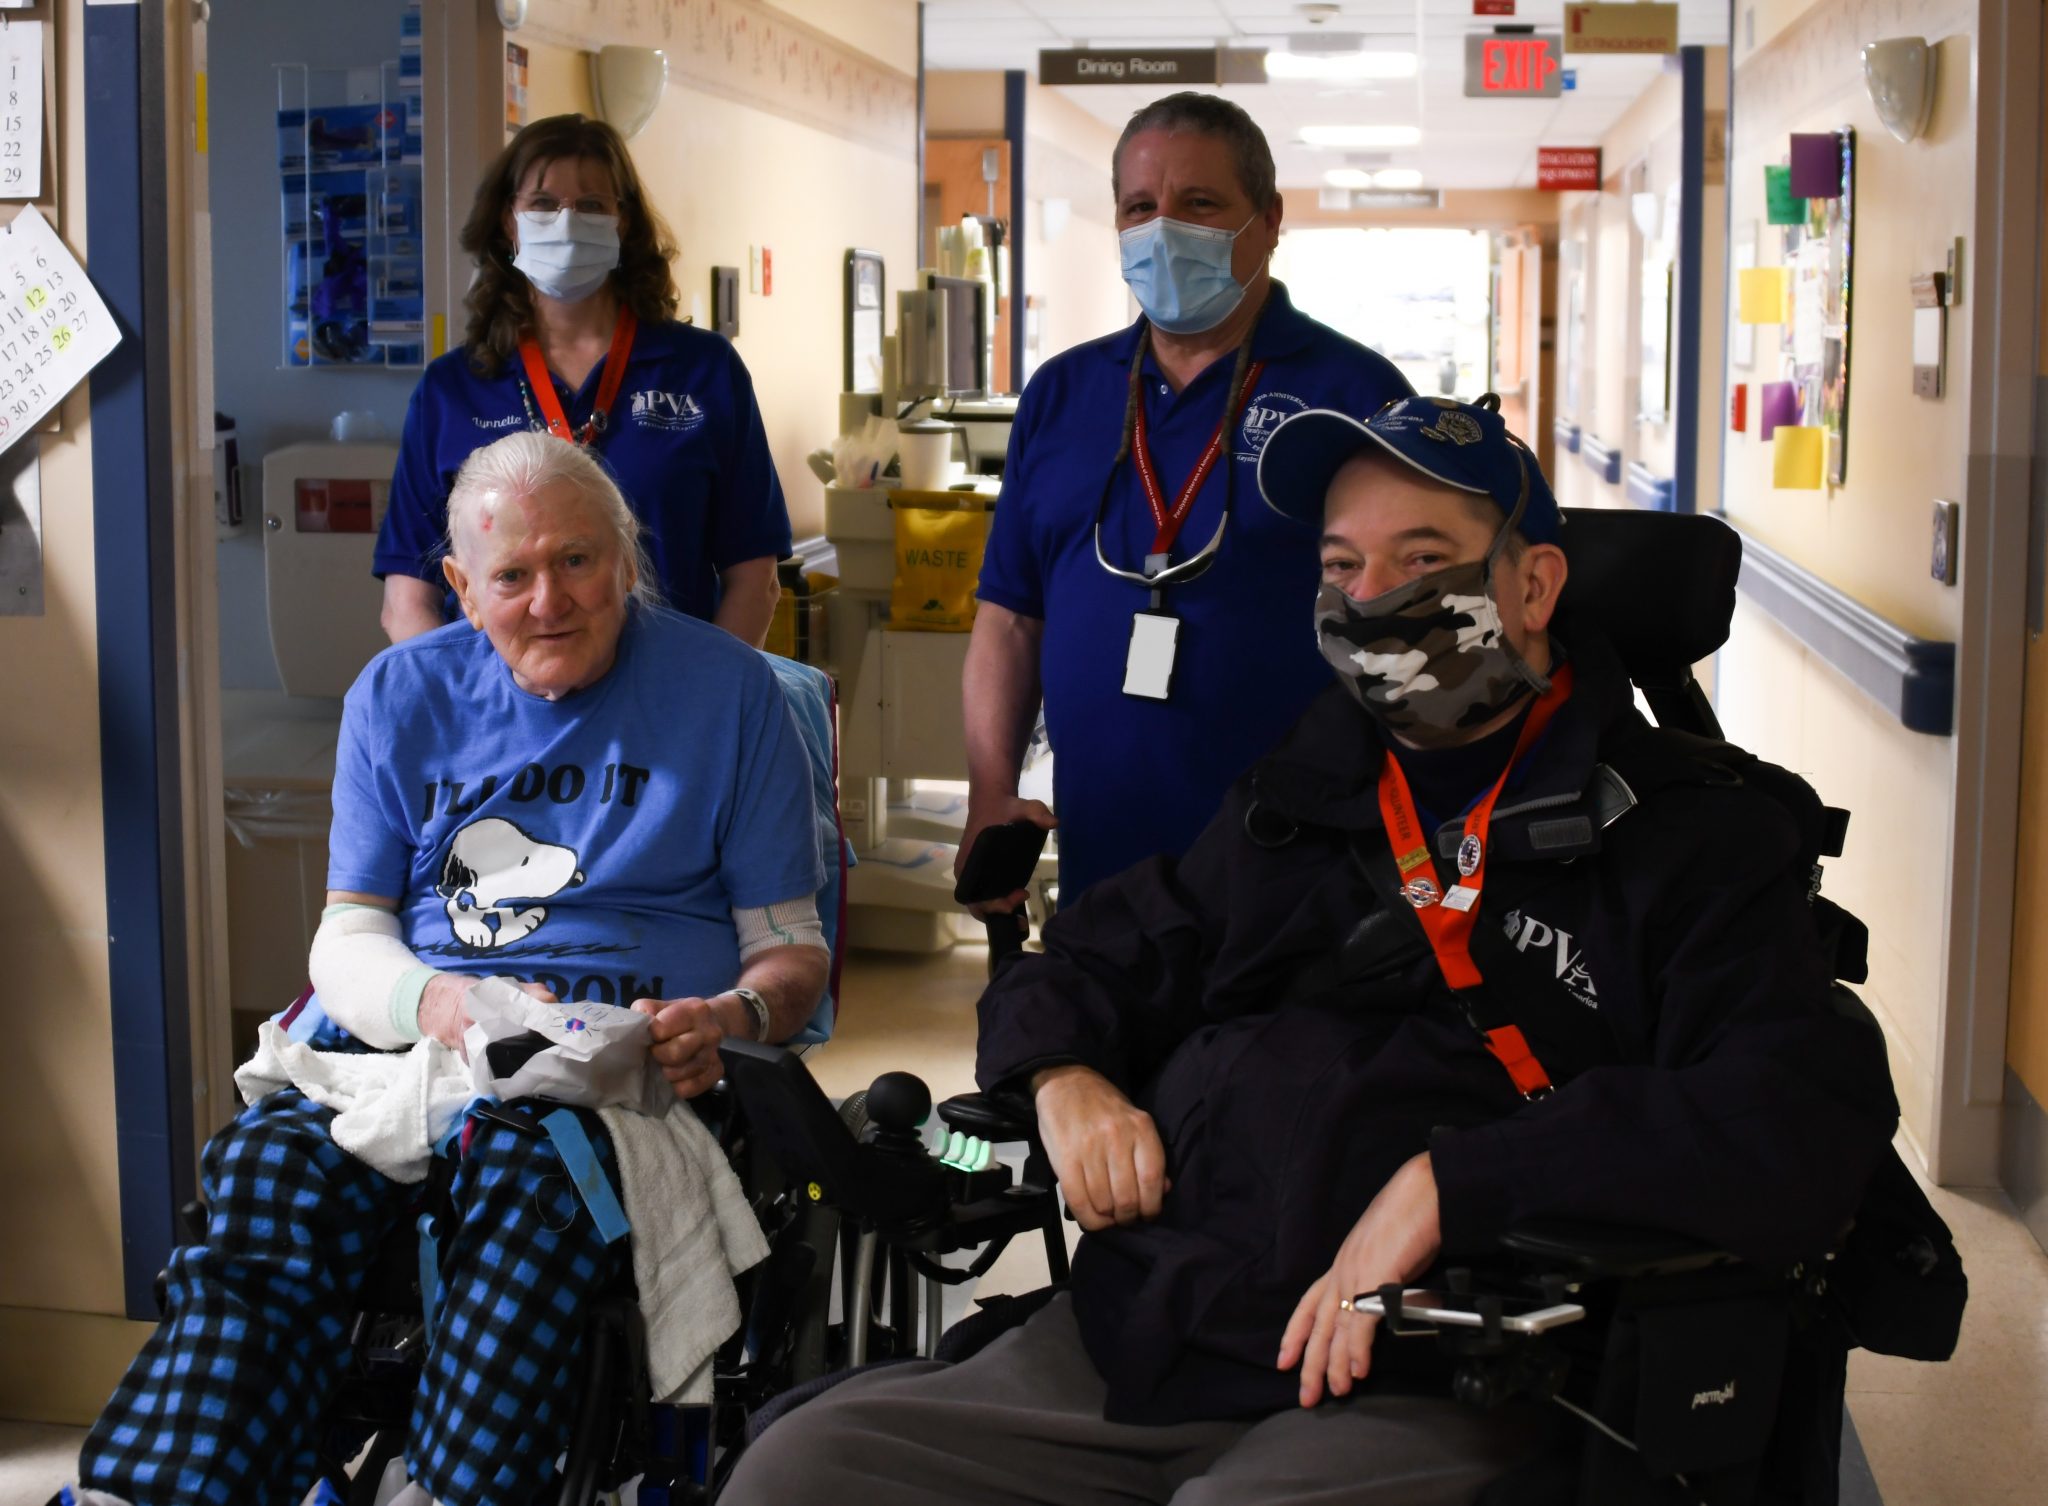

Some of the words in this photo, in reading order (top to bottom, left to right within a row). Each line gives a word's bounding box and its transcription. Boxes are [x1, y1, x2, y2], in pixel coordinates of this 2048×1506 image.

[11, 65, 16, 80] 1
[1077, 58, 1126, 77] Dining
[1130, 58, 1177, 74] Room
[1483, 40, 1549, 90] EXIT
[9, 91, 18, 105] 8
[5, 116, 22, 132] 15
[3, 142, 21, 157] 22
[4, 167, 22, 183] 29
[15, 270, 26, 286] 5
[36, 255, 47, 268] 6
[7, 306, 24, 324] 11
[26, 288, 45, 308] 12
[46, 271, 63, 290] 13
[1, 341, 18, 362] 17
[21, 325, 39, 345] 18
[40, 308, 56, 328] 19
[58, 291, 77, 312] 20
[15, 362, 34, 383] 24
[34, 344, 53, 366] 25
[52, 329, 71, 349] 26
[72, 310, 88, 332] 27
[10, 399, 29, 421] 30
[30, 383, 47, 404] 31
[644, 390, 703, 416] PVA
[1269, 392, 1311, 410] ANNIVERSAR
[1173, 493, 1190, 519] Paralyzed
[1185, 471, 1201, 494] Veterans
[1200, 446, 1215, 468] America
[904, 549, 969, 569] WASTE
[508, 762, 586, 804] DO
[600, 763, 650, 807] IT
[1516, 915, 1598, 996] PVA
